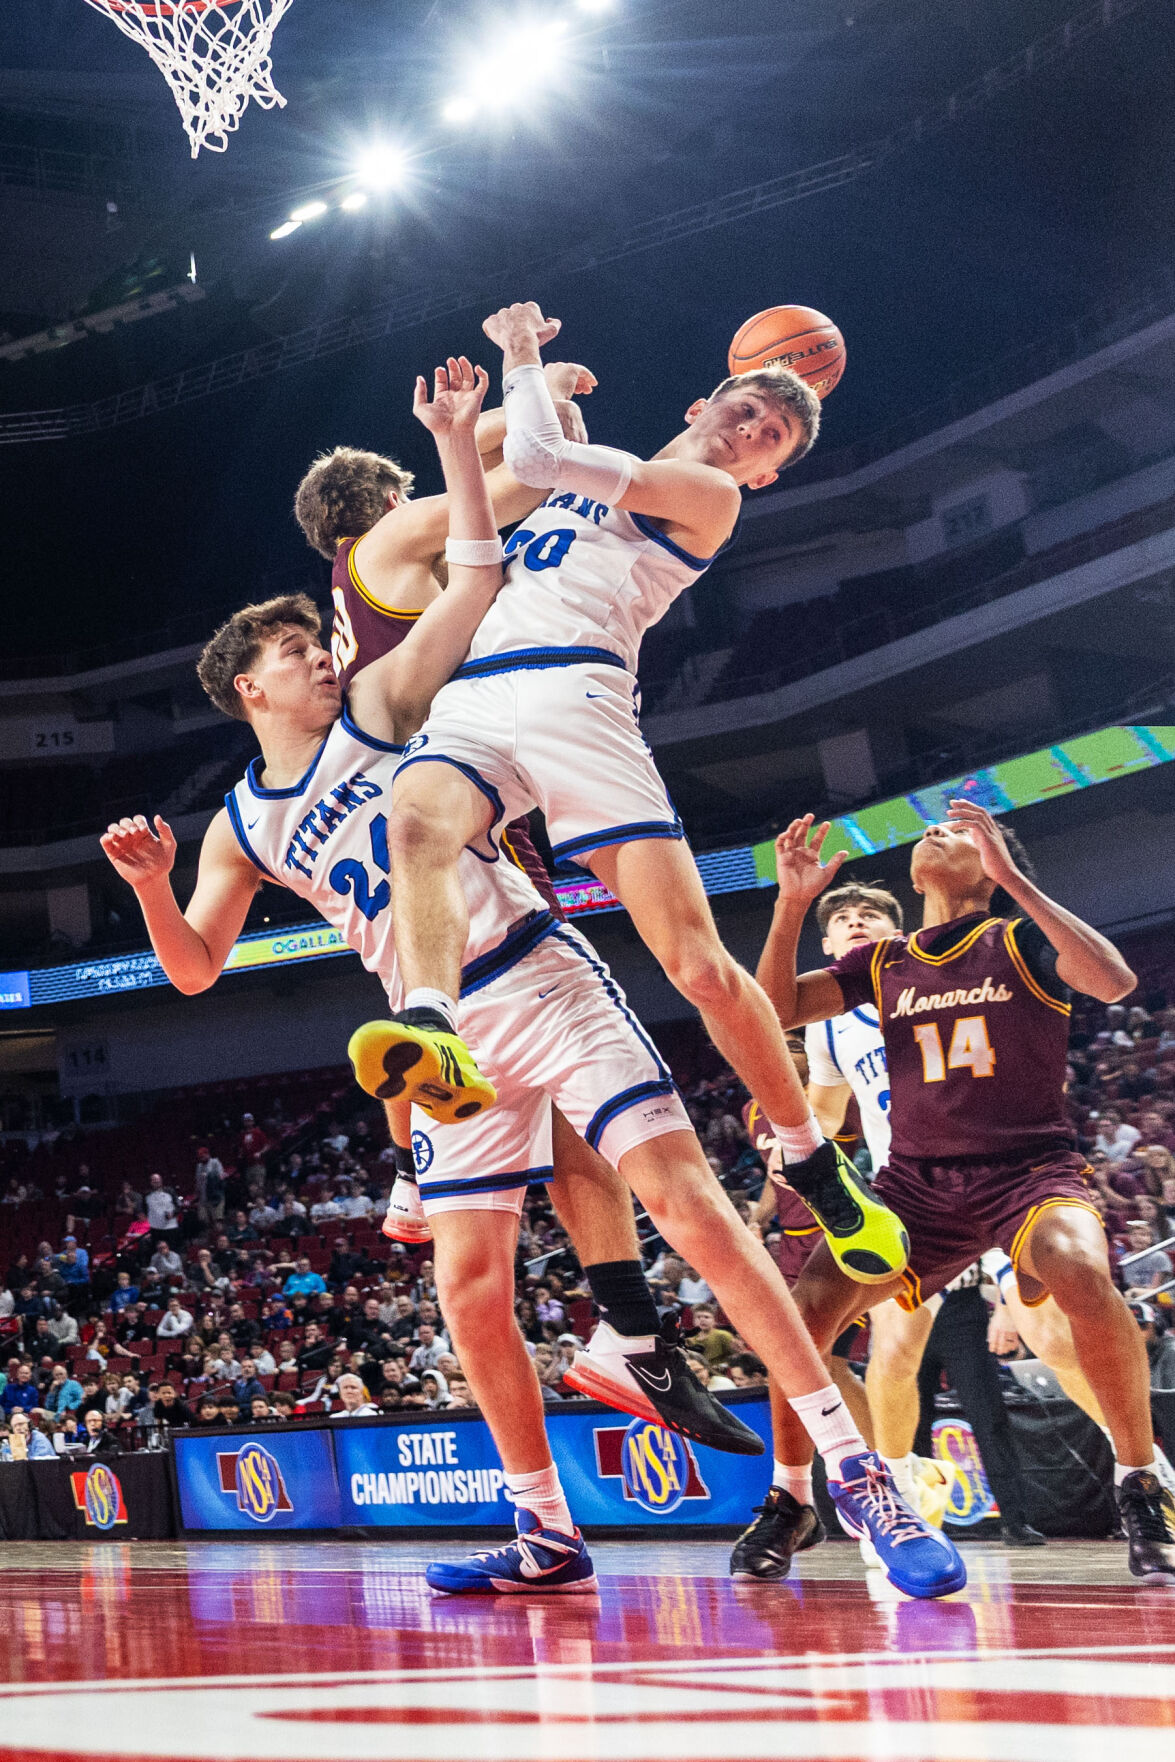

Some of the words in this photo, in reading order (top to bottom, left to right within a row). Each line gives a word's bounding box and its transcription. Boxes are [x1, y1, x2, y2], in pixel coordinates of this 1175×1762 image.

[35, 731, 74, 748] 215
[285, 772, 383, 880] TITANS
[272, 932, 347, 954] OGALLAL
[889, 976, 1013, 1019] Monarchs
[855, 1046, 889, 1085] TIT
[913, 1015, 996, 1083] 14
[397, 1431, 459, 1467] STATE
